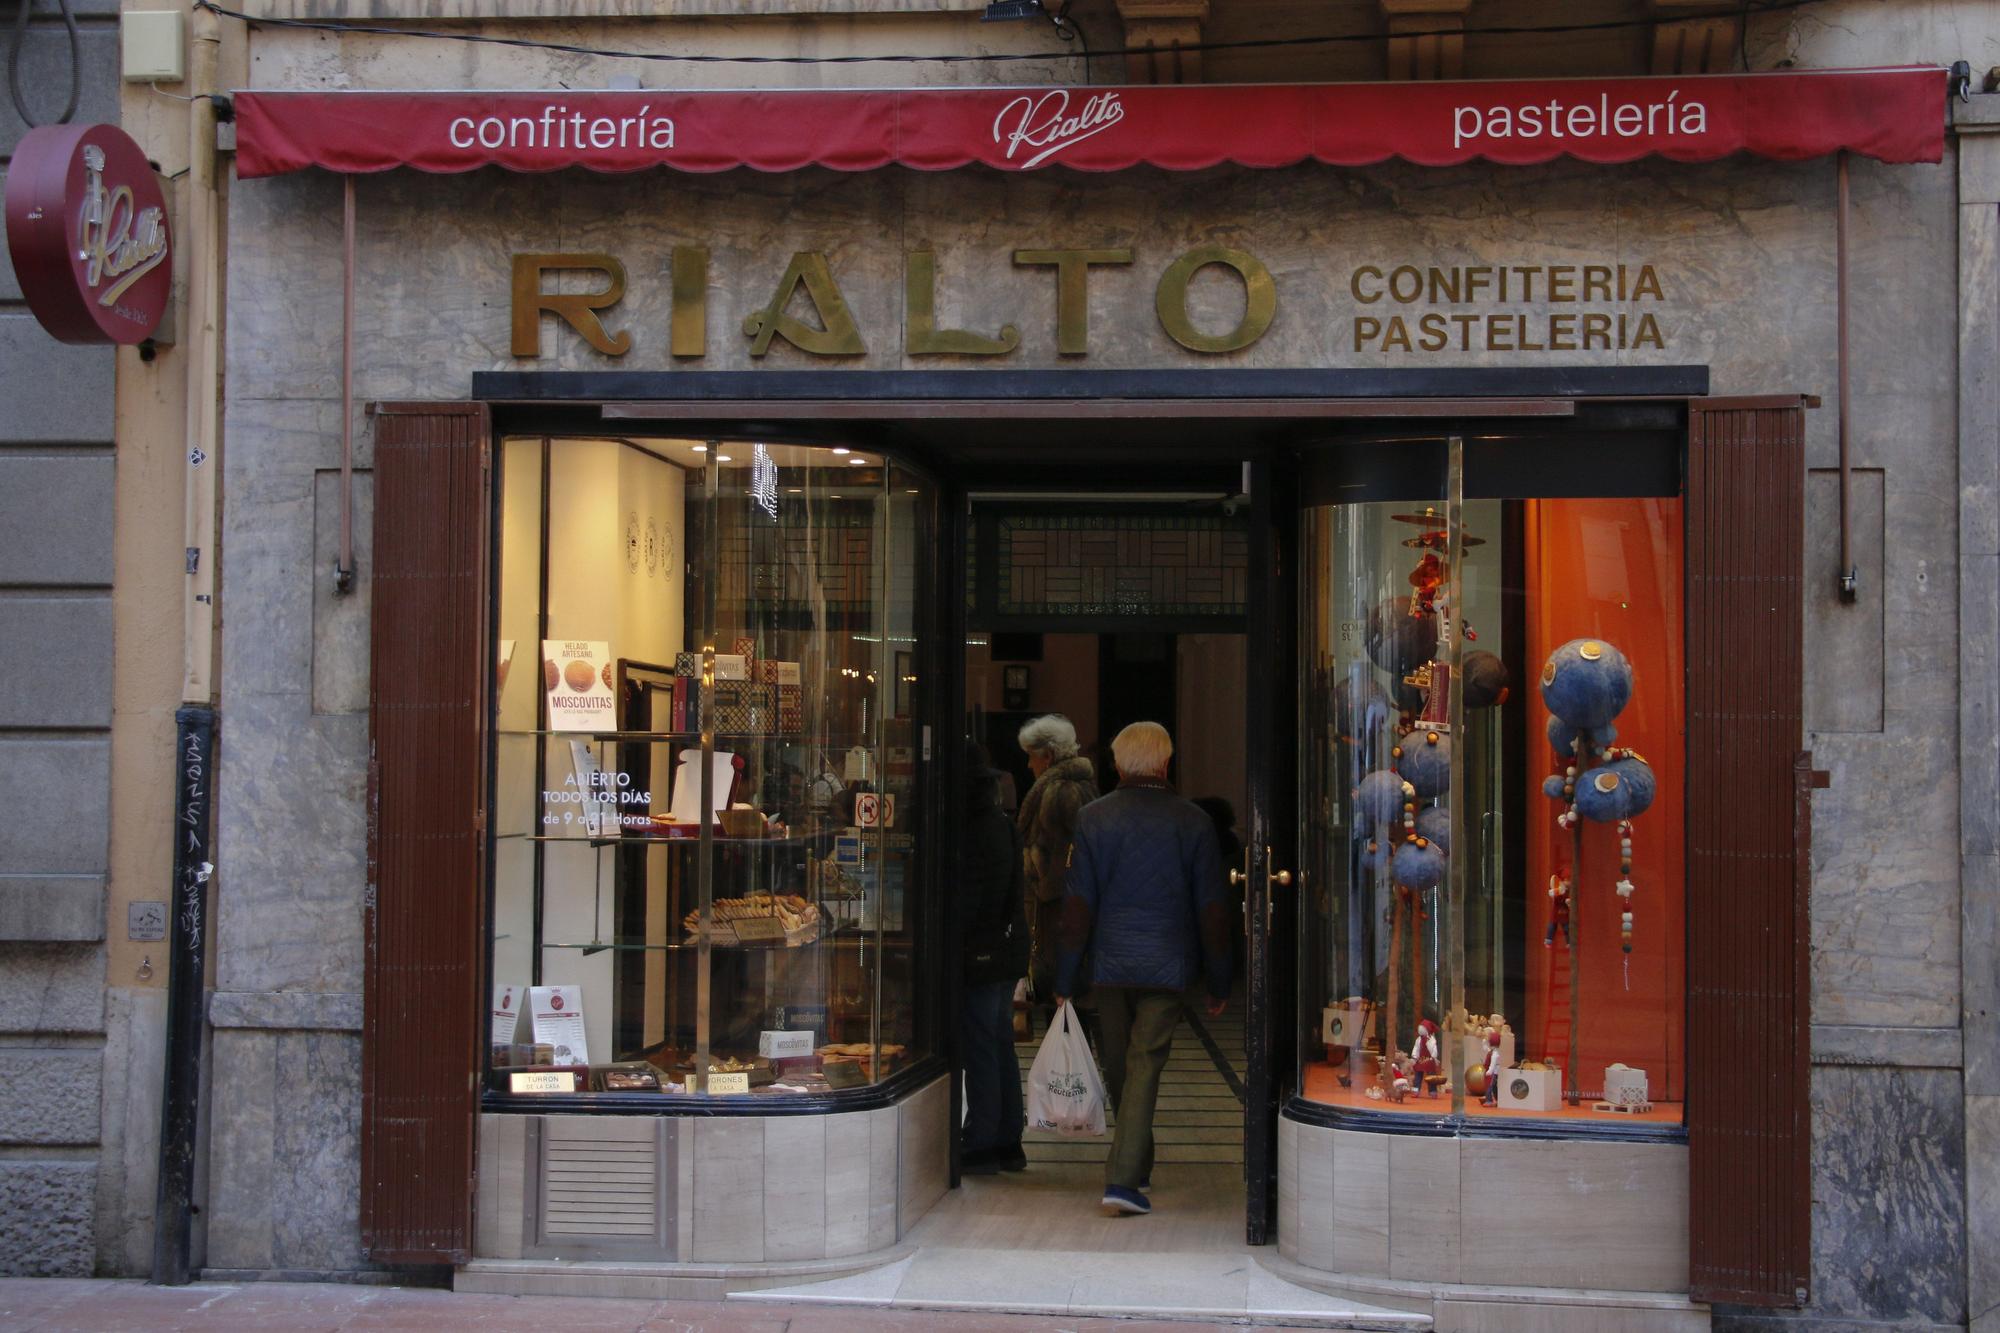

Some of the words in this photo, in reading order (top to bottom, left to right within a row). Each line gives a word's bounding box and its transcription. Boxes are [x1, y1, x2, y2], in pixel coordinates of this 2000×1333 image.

[450, 106, 675, 148] confitería
[993, 89, 1124, 169] Rialto
[1454, 90, 1706, 148] pastelería
[1351, 264, 1665, 304] CONFITERIA
[511, 246, 1277, 357] RIALTO
[1353, 313, 1665, 352] PASTELERIA
[562, 650, 593, 658] ARTESANO
[565, 642, 589, 650] HELADO
[552, 696, 613, 709] MOSCOVITAS
[564, 772, 631, 786] ABIERTO
[543, 791, 590, 803] TODOS
[593, 791, 618, 803] LOS
[621, 788, 652, 803] DÍAS
[543, 811, 560, 825] de
[564, 811, 574, 825] 9
[577, 816, 587, 825] a
[613, 812, 652, 825] Horas
